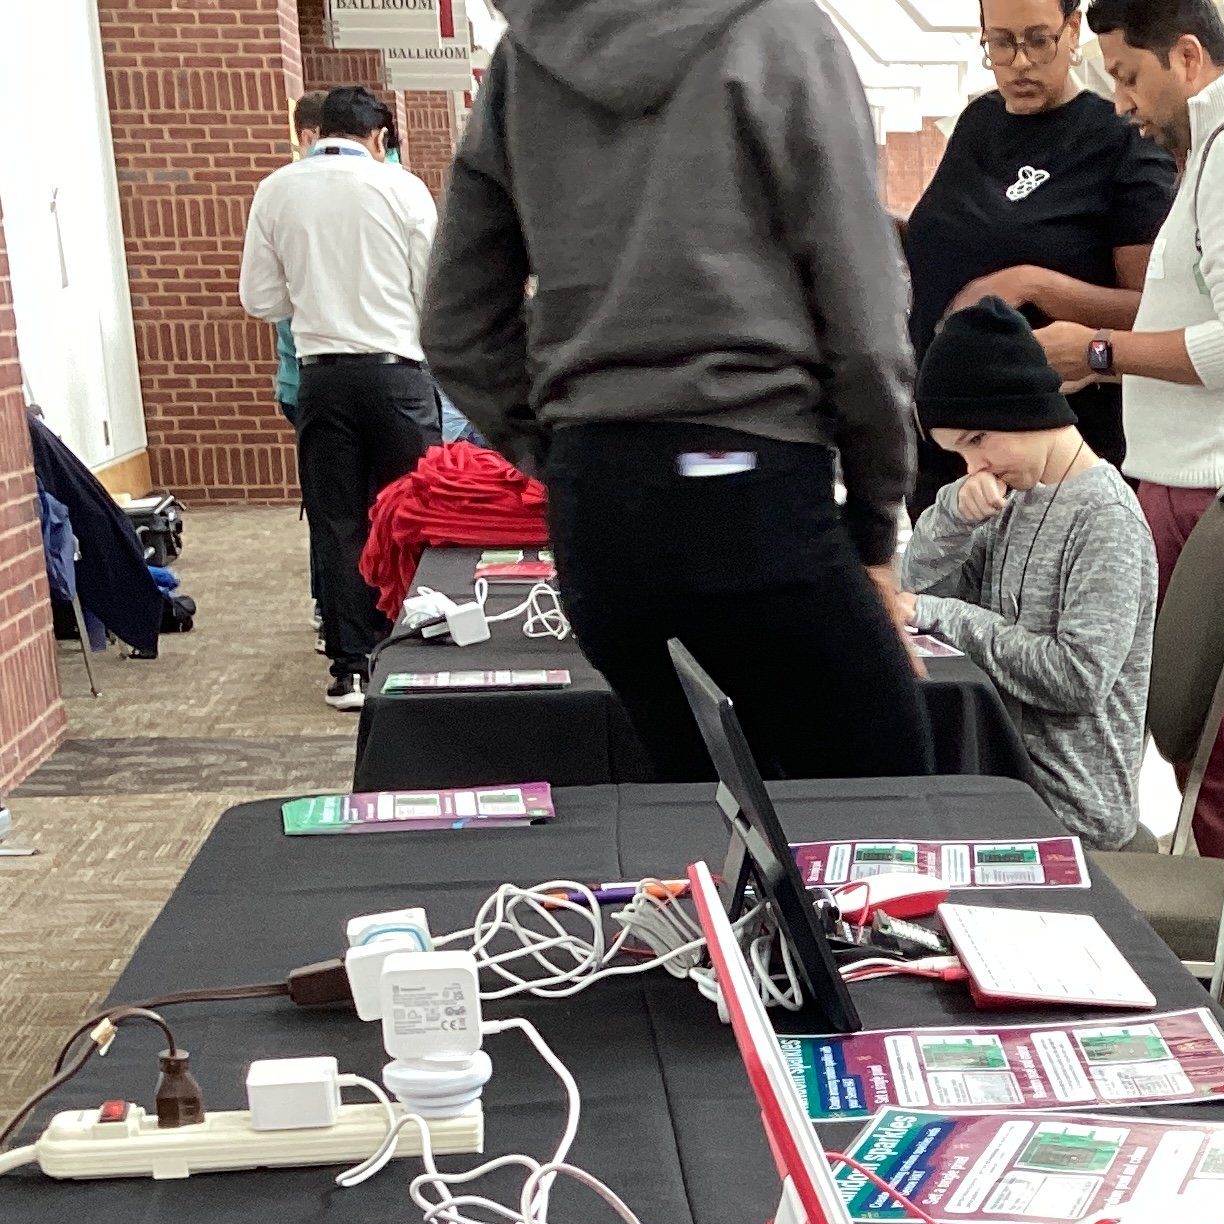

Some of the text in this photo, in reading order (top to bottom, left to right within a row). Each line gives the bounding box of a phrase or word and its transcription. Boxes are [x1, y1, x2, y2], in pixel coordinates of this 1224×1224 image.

[336, 0, 433, 10] BALLROOM
[389, 47, 469, 59] BALLROOM
[864, 1115, 917, 1161] sparkles
[922, 1193, 942, 1204] Set
[935, 1169, 959, 1187] single
